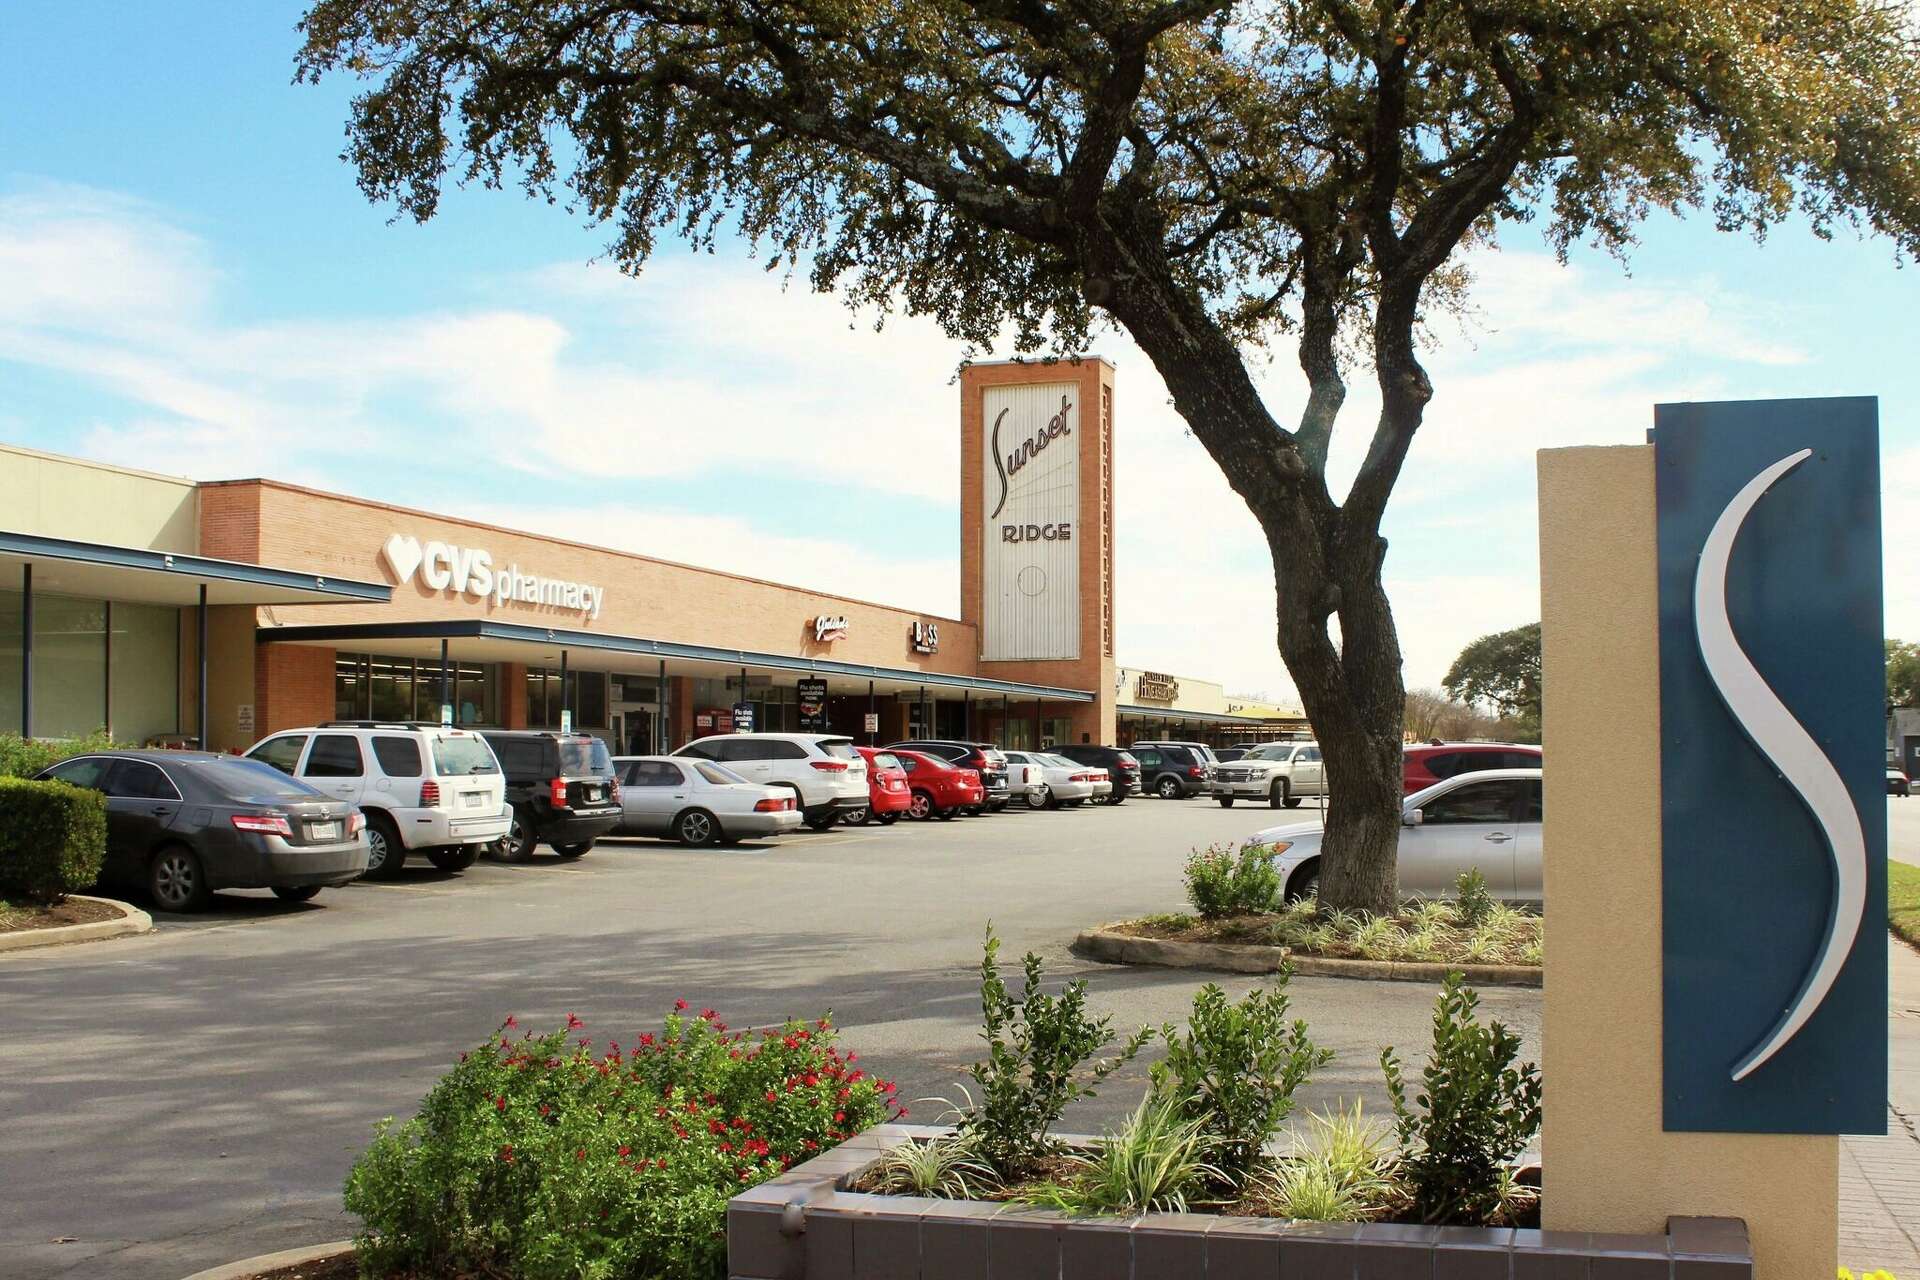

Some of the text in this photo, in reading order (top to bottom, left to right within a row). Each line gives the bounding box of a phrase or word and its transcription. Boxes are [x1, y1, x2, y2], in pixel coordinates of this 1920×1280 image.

[992, 395, 1072, 519] Sunset
[1002, 524, 1071, 543] RIDGE
[420, 540, 604, 620] CVS pharmacy
